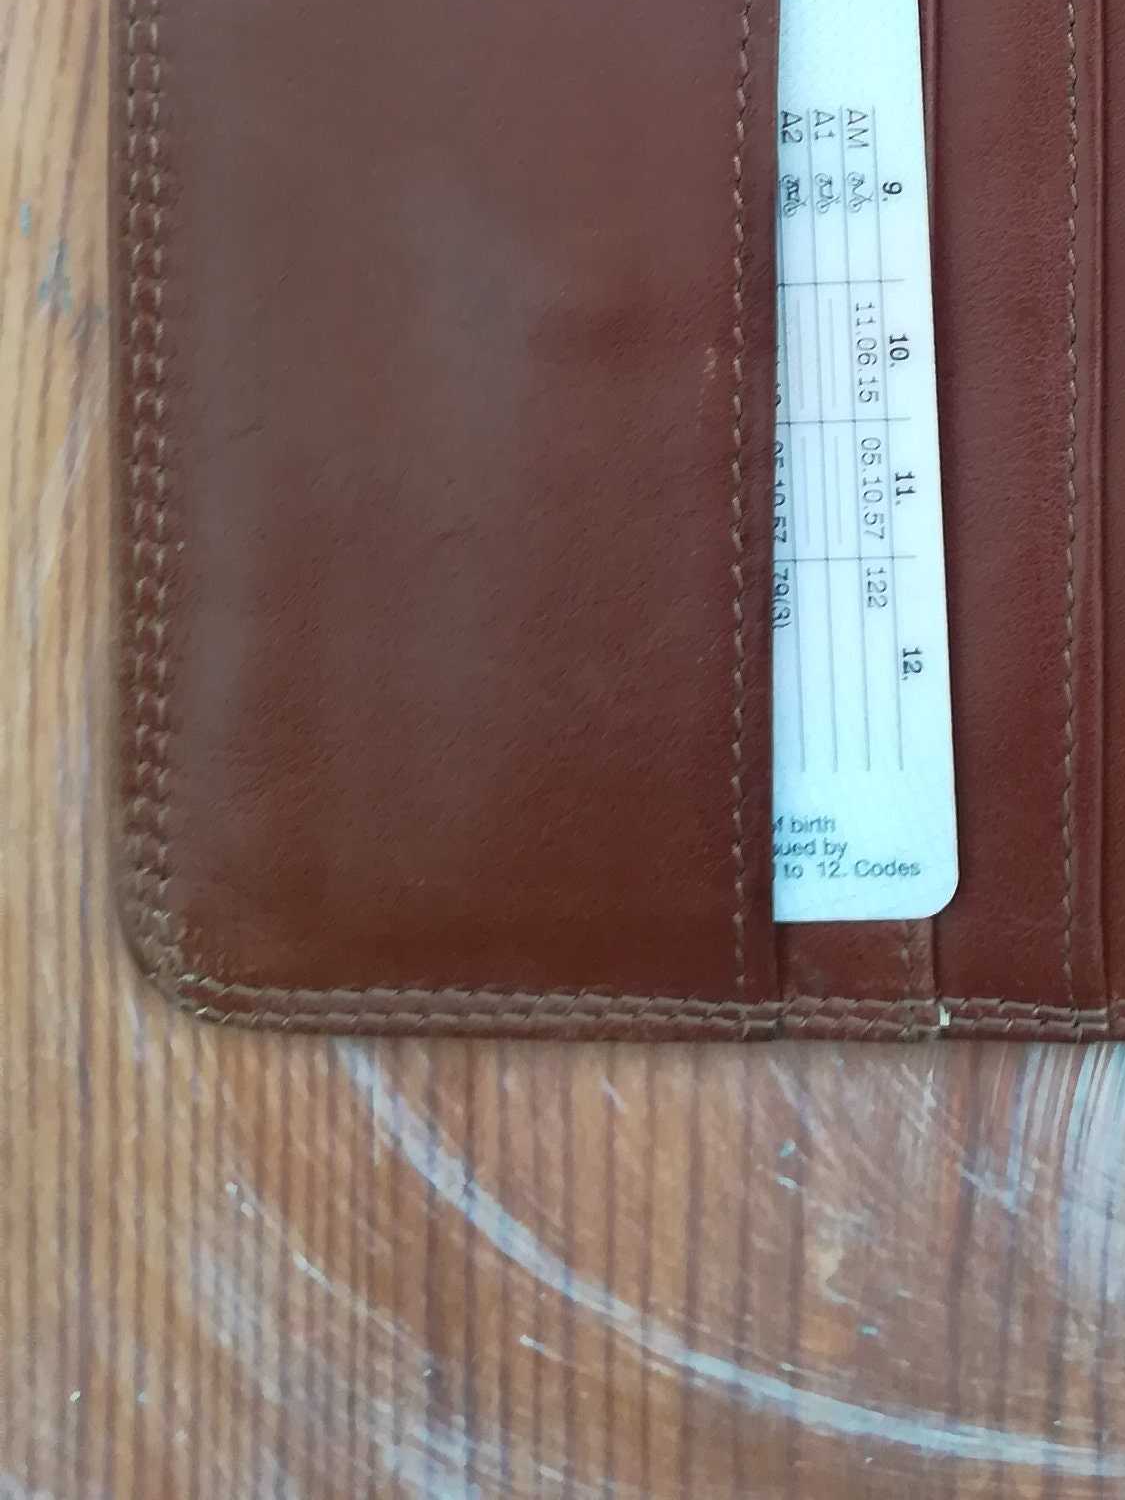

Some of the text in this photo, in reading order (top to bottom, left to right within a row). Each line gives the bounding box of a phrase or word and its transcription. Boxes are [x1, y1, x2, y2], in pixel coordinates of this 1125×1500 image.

[781, 110, 803, 144] A2
[813, 109, 835, 140] A1
[847, 108, 869, 148] AM
[882, 181, 902, 201] 9.
[889, 333, 911, 368] 10.
[855, 302, 889, 609] 11.06.15 05.10.57 122
[894, 470, 917, 506] 11.
[902, 646, 924, 681] 12.
[789, 814, 837, 834] birth
[823, 837, 849, 860] by
[783, 862, 804, 879] to
[816, 859, 848, 879] 12.
[854, 858, 922, 879] Codes
